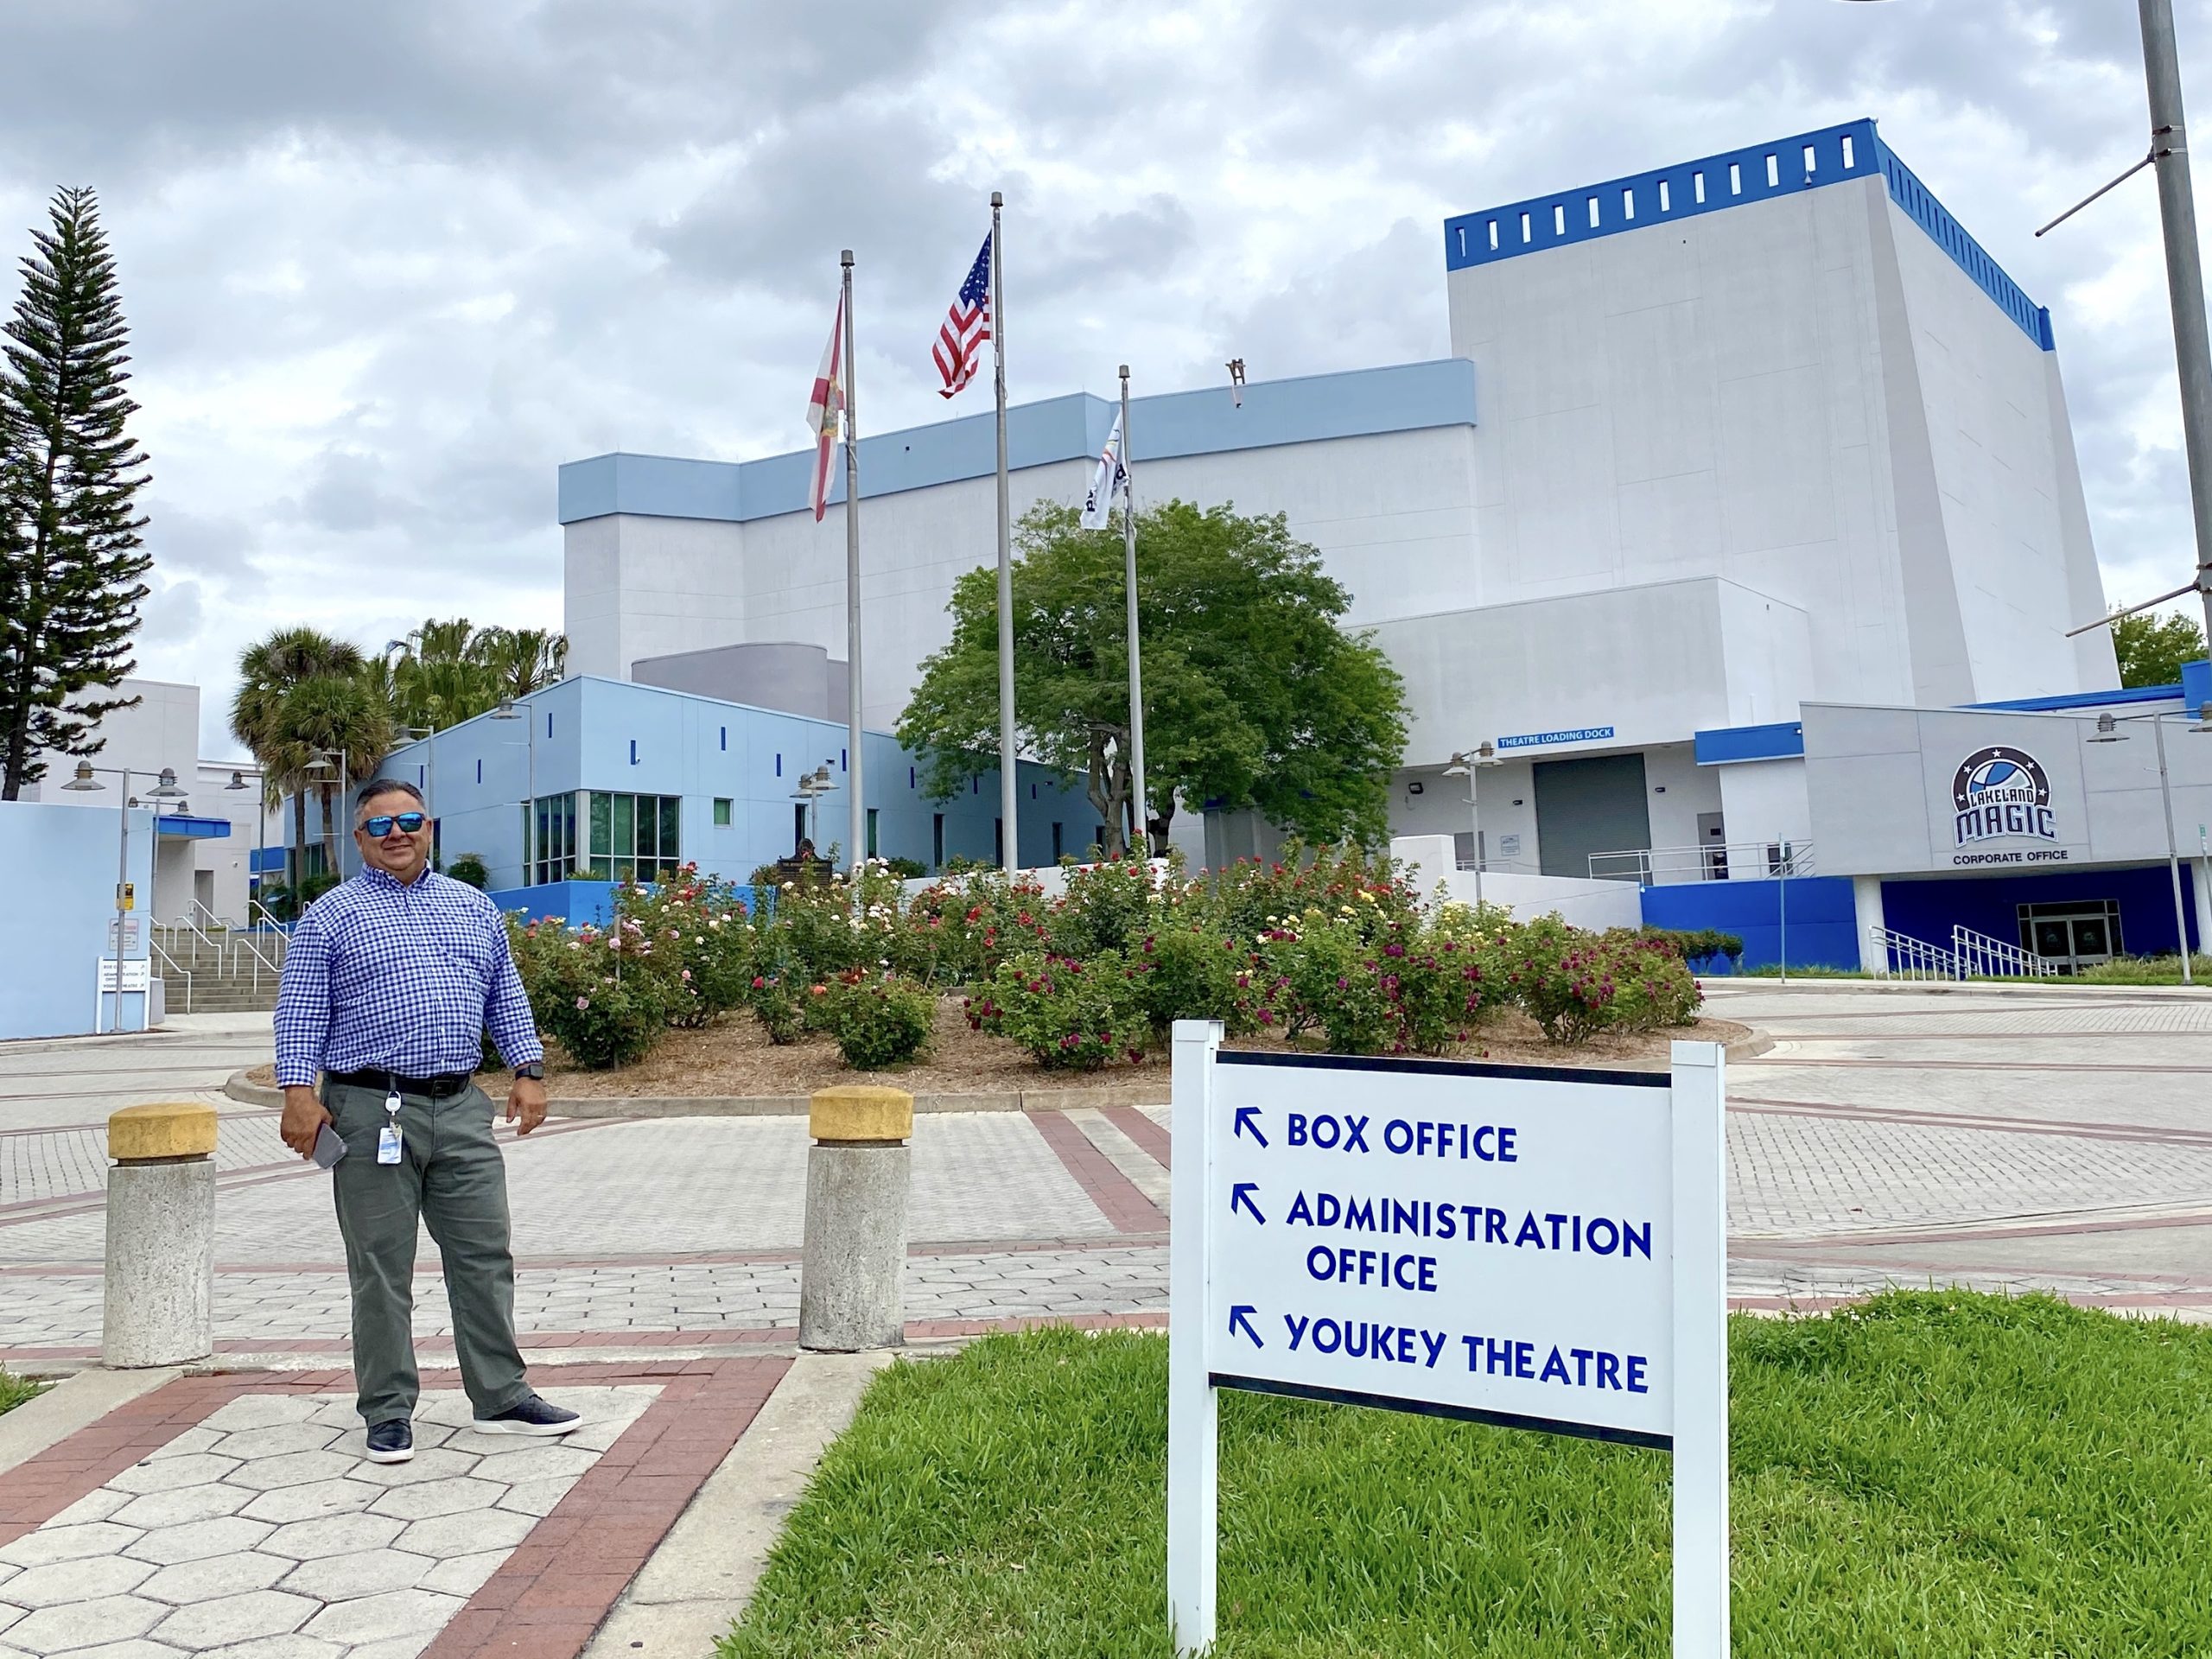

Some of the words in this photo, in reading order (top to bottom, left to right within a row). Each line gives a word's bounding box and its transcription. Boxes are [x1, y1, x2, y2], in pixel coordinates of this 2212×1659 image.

[1500, 735, 1541, 747] THEATRE
[1541, 731, 1583, 743] LOADING
[1584, 728, 1611, 739] DOCK
[1969, 788, 2034, 807] LAKELAND
[1955, 804, 2056, 845] MAGIC
[1953, 852, 2023, 865] CORPORATE
[2026, 850, 2069, 861] OFFICE
[1287, 1113, 1370, 1154] BOX
[1383, 1119, 1518, 1163] OFFICE
[1286, 1189, 1651, 1262] ADMINISTRATION
[1306, 1245, 1438, 1293] OFFICE
[1284, 1313, 1447, 1369] YOUKEY
[1461, 1335, 1649, 1395] THEATRE
